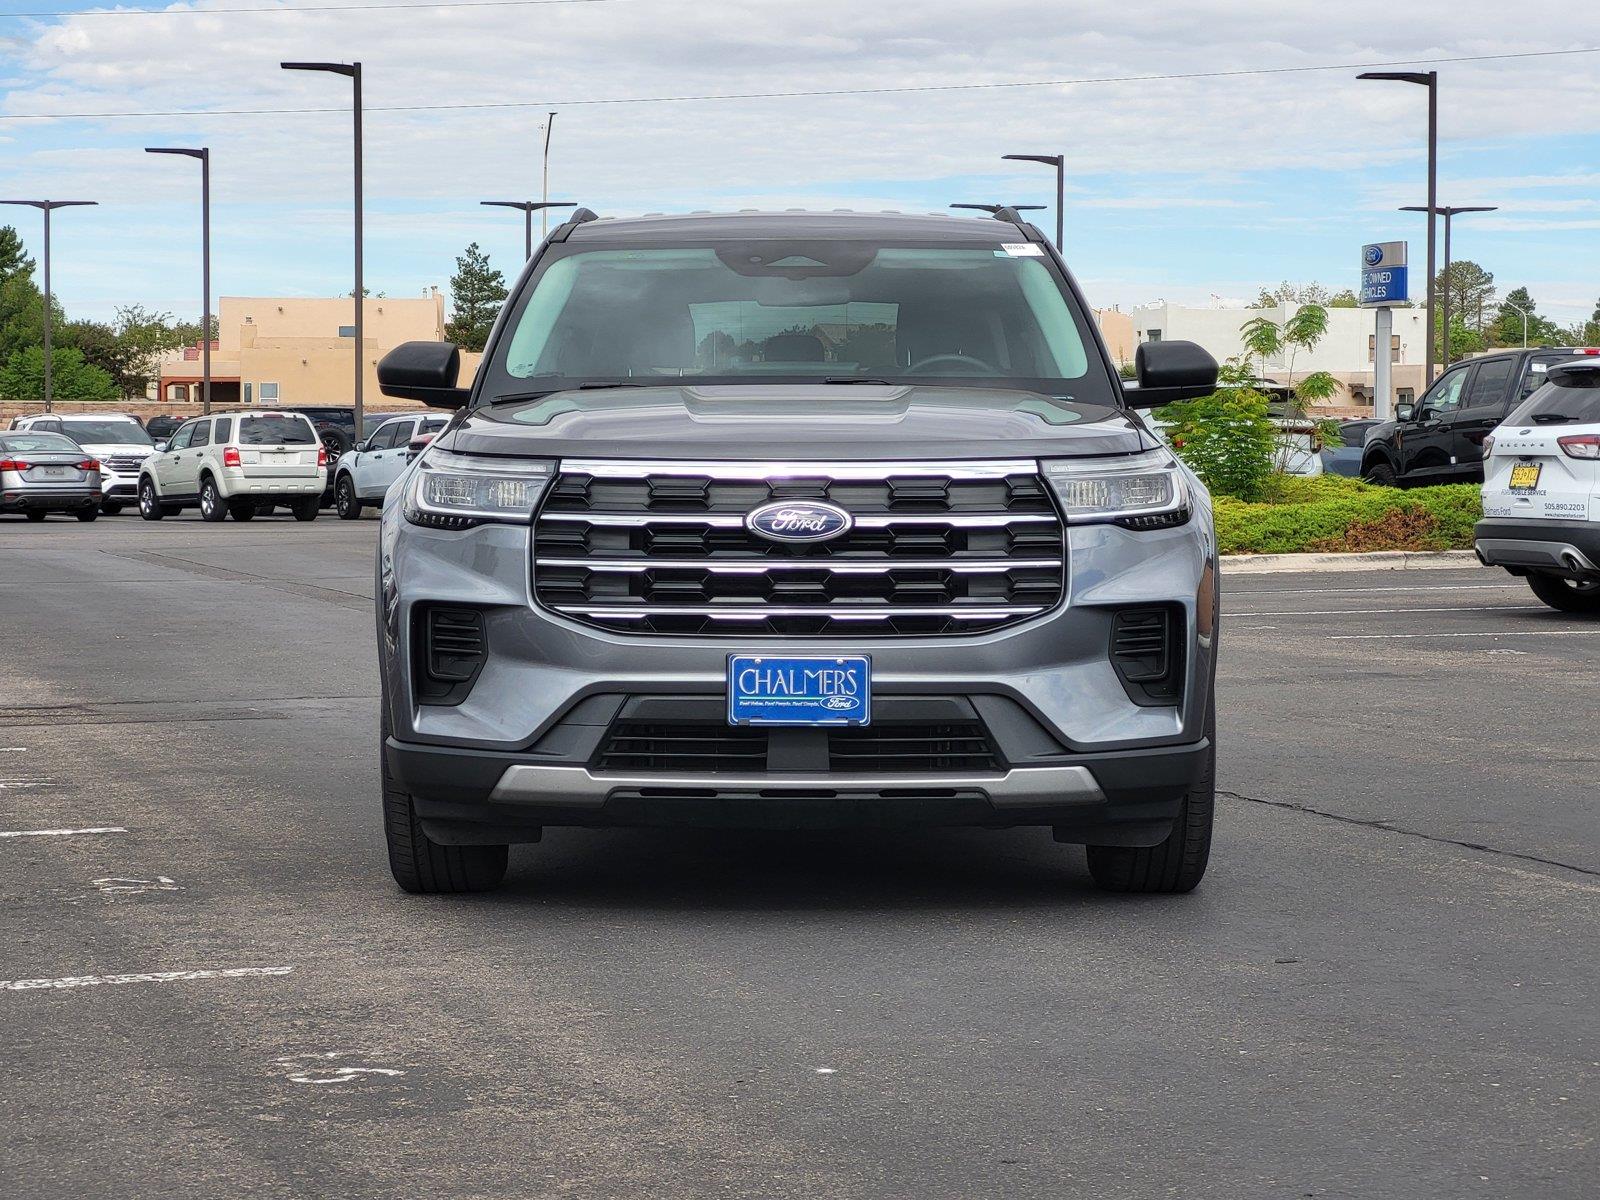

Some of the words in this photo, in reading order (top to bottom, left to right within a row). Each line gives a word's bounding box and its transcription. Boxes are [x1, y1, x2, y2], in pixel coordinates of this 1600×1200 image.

[1362, 286, 1387, 299] EHICLES
[1500, 506, 1512, 516] Ford
[1544, 502, 1585, 511] 505.890.2203
[771, 509, 828, 531] Ford
[738, 668, 858, 695] CHALMERS
[827, 697, 852, 708] Ford
